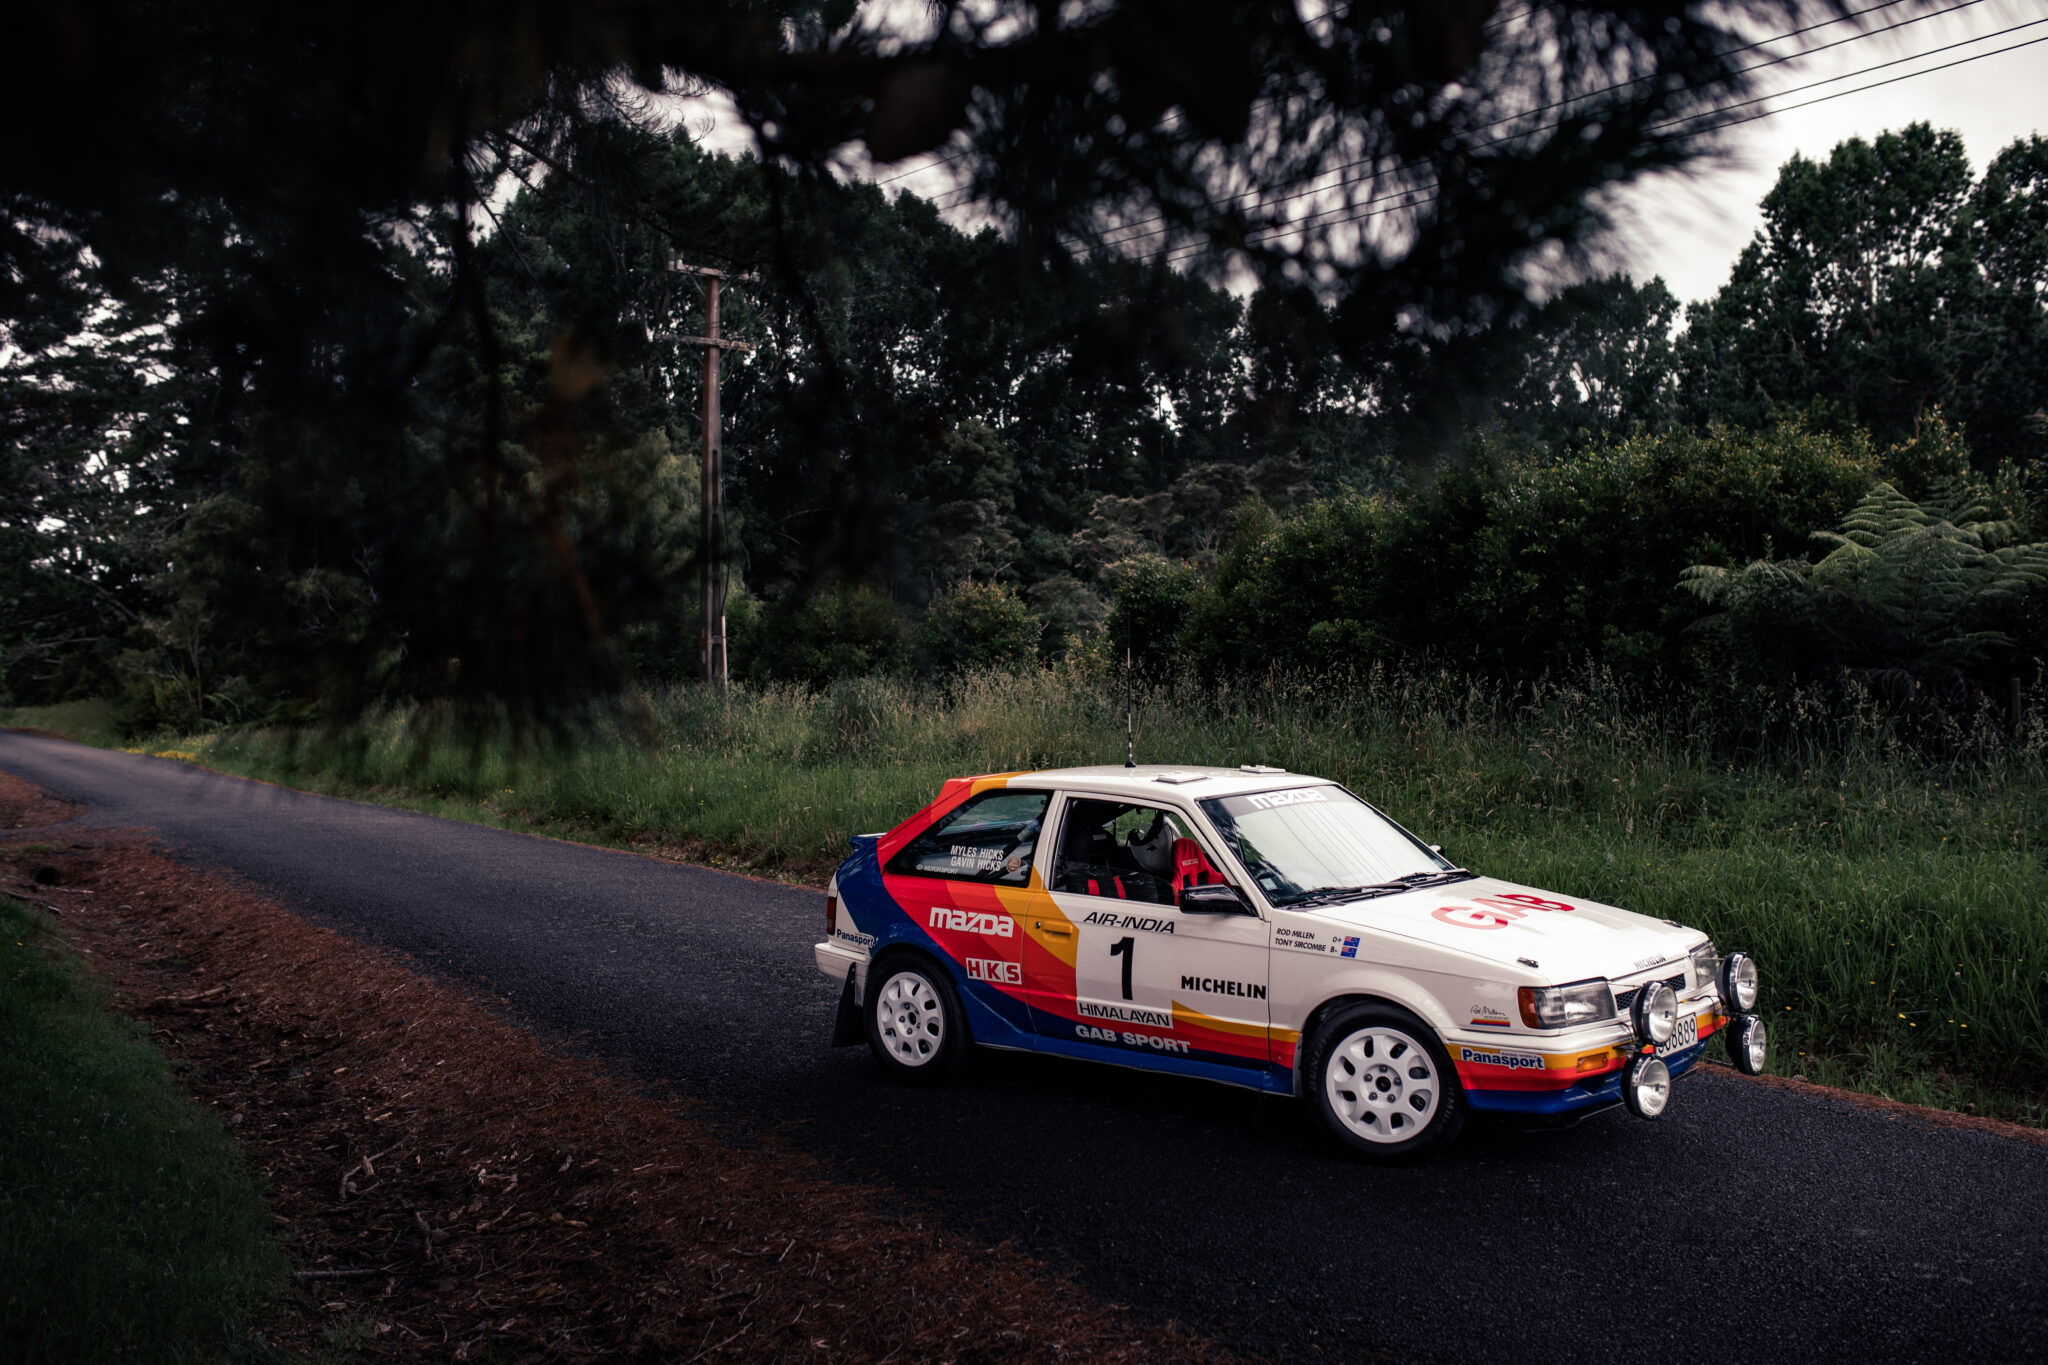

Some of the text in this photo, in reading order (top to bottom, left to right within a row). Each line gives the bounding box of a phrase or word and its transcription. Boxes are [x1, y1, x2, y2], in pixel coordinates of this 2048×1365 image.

[951, 845, 1004, 860] MYLES HICKS
[951, 856, 1001, 872] GAVIN HICKS
[1084, 911, 1175, 934] AIR-INDIA
[1431, 894, 1575, 930] GAB
[1275, 938, 1293, 947] TONY
[1294, 941, 1326, 952] SIRCOMBE
[1276, 928, 1291, 936] ROD
[1292, 930, 1315, 940] MILLEN
[967, 959, 1021, 982] HKS
[1110, 936, 1135, 1000] 1
[1181, 976, 1266, 1000] MICHELIN
[1079, 1003, 1170, 1026] HIMALAYAN
[1075, 1025, 1190, 1053] GAB SPORT
[1658, 1018, 1695, 1053] 8889
[1462, 1048, 1544, 1068] Panasport
